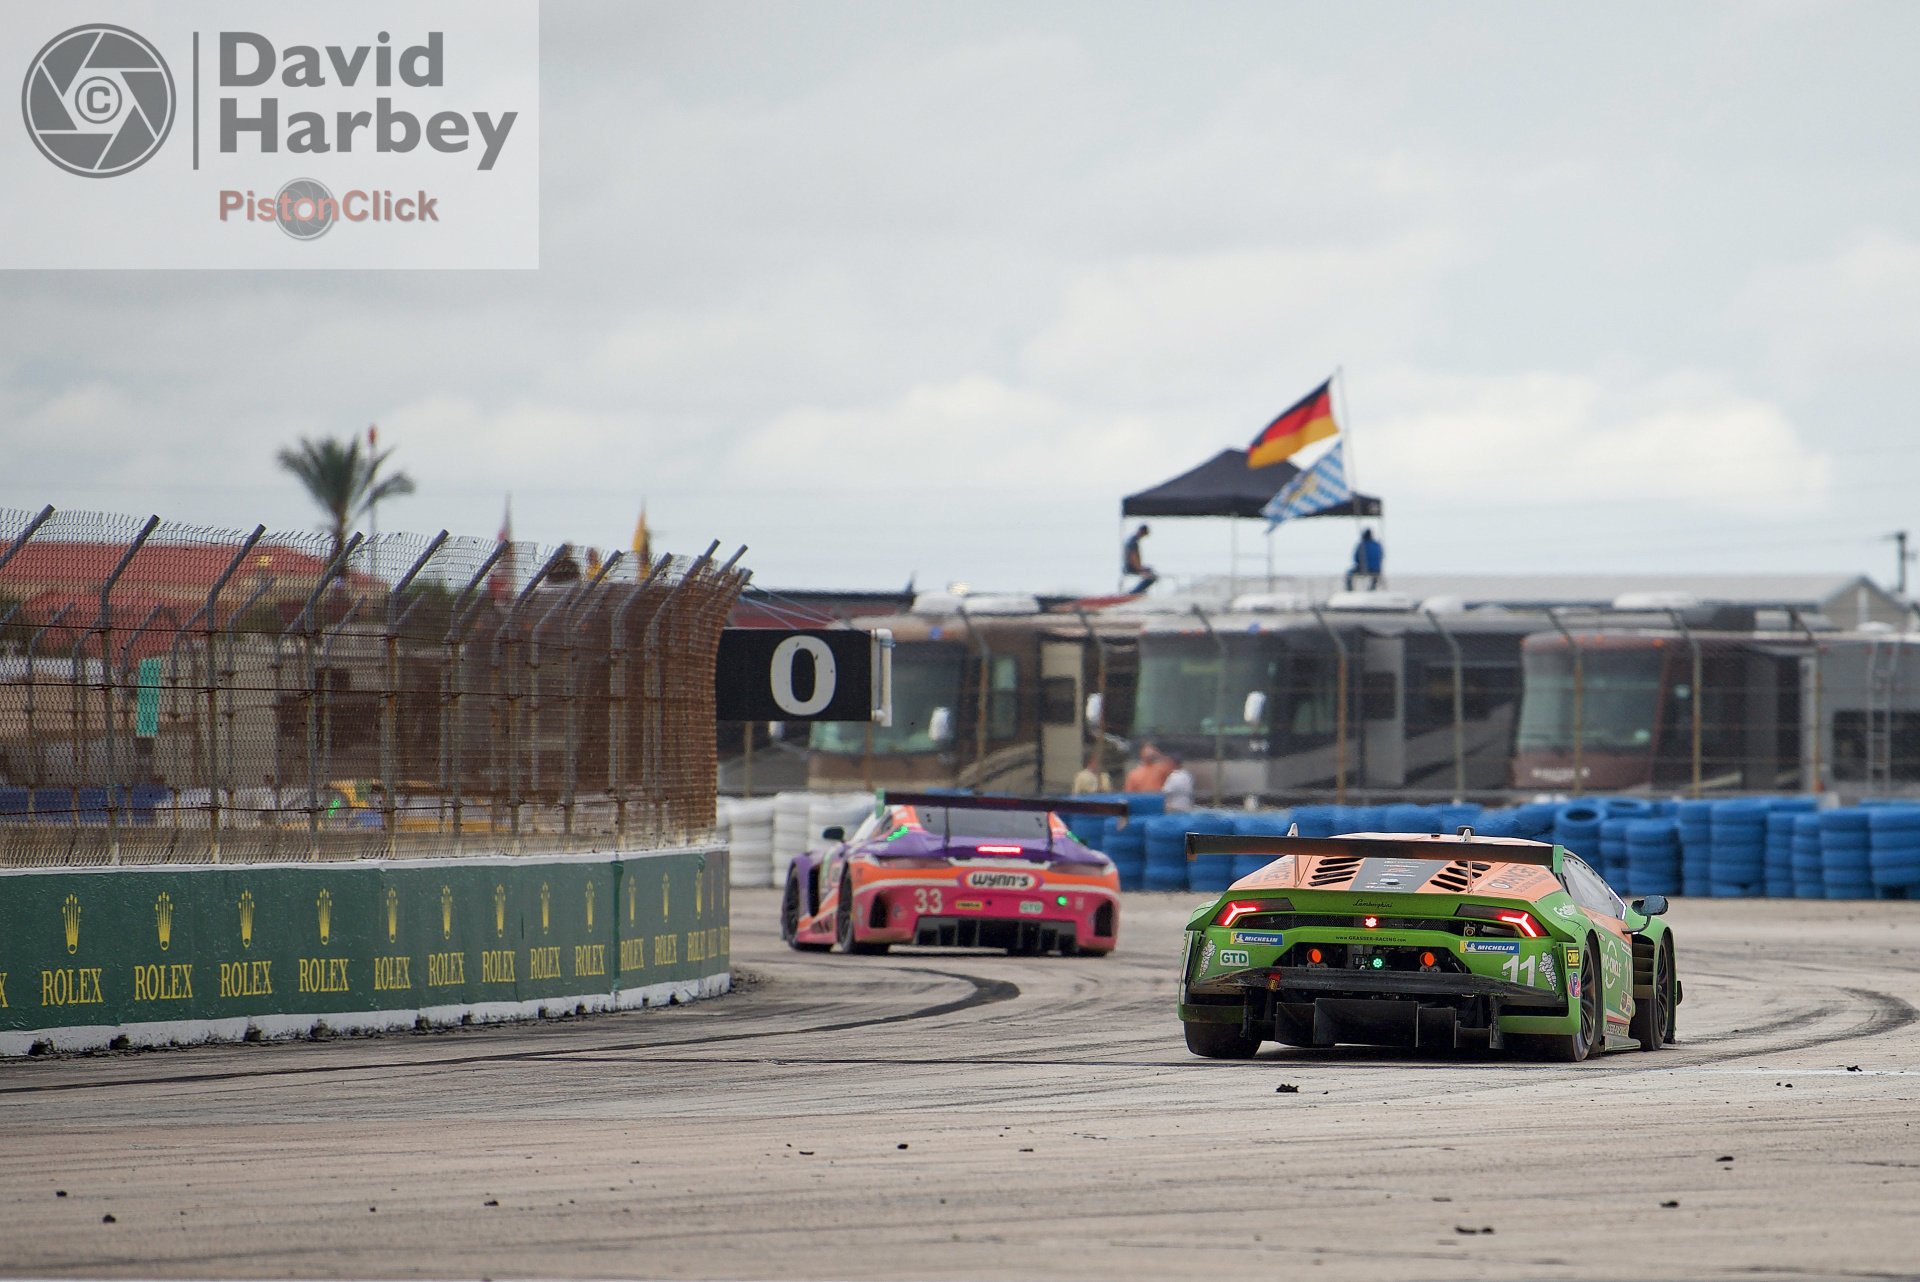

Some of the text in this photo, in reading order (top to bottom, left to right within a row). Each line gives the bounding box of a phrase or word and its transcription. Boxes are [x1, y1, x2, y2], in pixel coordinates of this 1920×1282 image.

[770, 635, 837, 716] 0
[914, 888, 943, 914] 33
[1244, 935, 1279, 943] MICHELIN
[40, 968, 104, 1007] ROLEX
[134, 963, 193, 1001] ROLEX
[219, 960, 273, 998] ROLEX
[298, 957, 350, 993] ROLEX
[428, 952, 465, 987] ROLEX
[481, 950, 516, 983] ROLEX
[529, 946, 561, 980] ROLEX
[574, 944, 605, 977] ROLEX
[620, 938, 644, 972] ROLEX
[654, 934, 677, 966] ROLEX
[1221, 952, 1248, 964] GTD
[1502, 955, 1536, 987] 11
